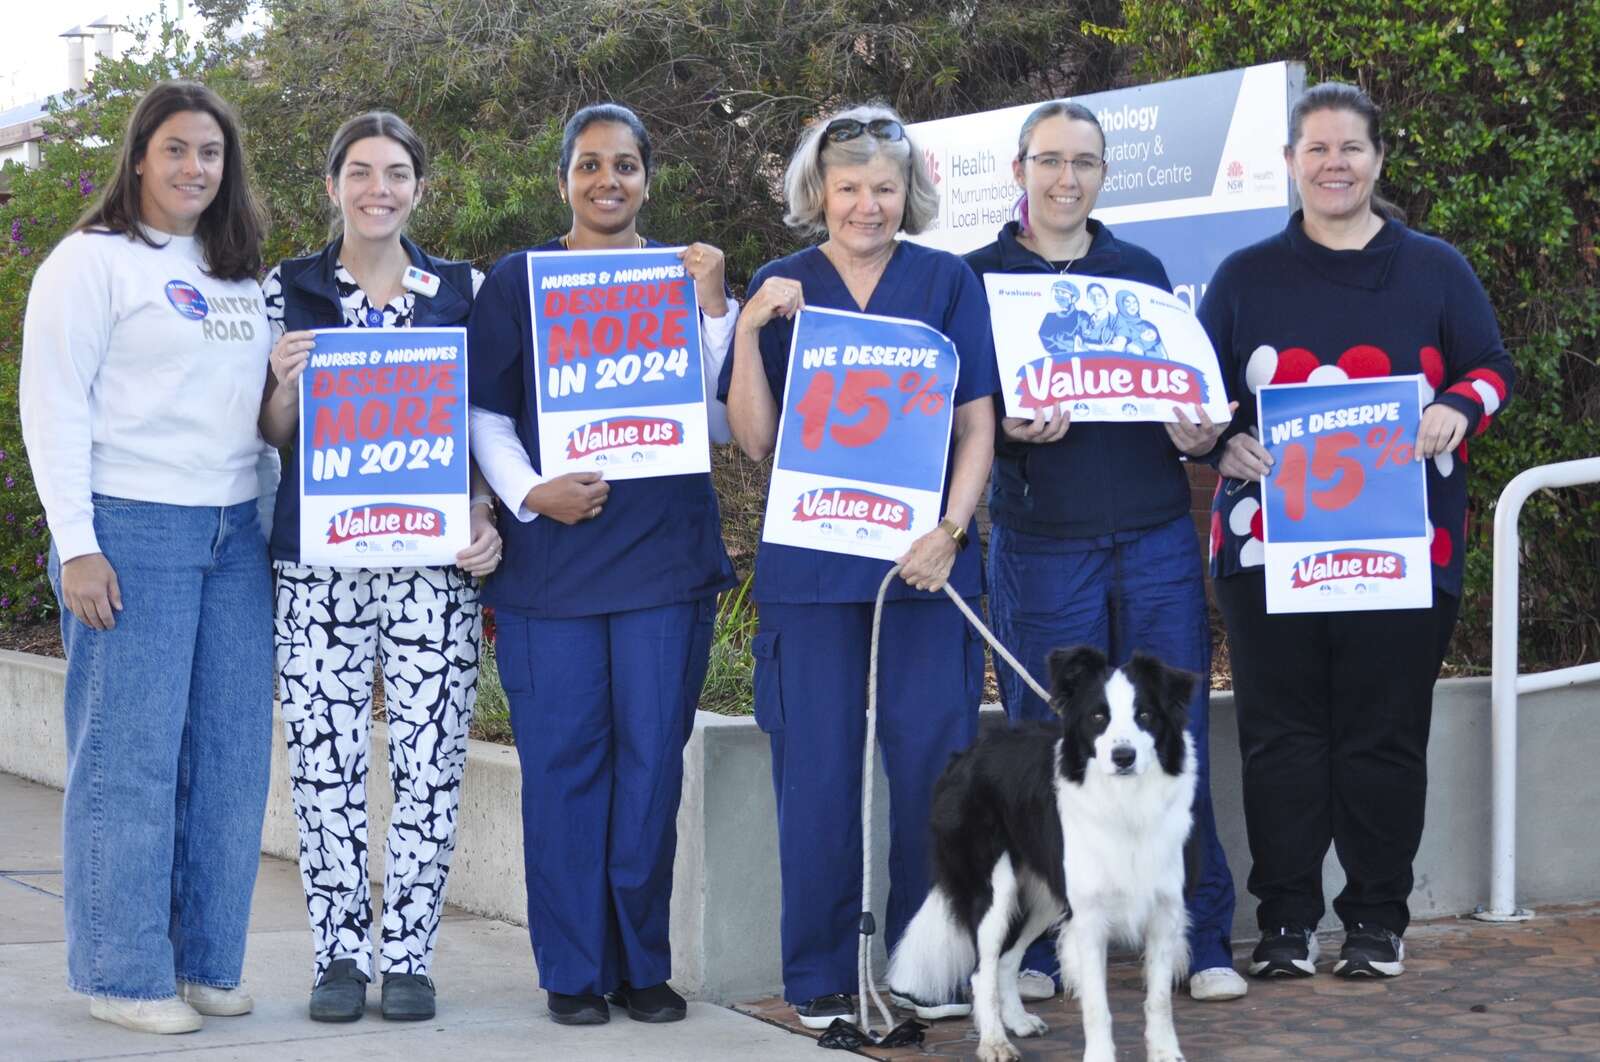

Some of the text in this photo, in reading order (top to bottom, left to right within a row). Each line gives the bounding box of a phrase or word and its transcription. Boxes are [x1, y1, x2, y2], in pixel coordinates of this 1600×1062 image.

[1097, 105, 1159, 132] thology
[951, 150, 996, 177] Health
[1104, 135, 1164, 162] oratory &
[1101, 163, 1192, 192] ection Centre
[951, 181, 1020, 206] Murrumbidge
[951, 207, 979, 228] Local
[541, 265, 685, 289] NURSES & MIDWIVES
[543, 281, 688, 318] DESERVE
[202, 319, 255, 341] ROAD
[548, 309, 688, 365] MORE
[311, 346, 458, 368] NURSES & MIDWIVES
[548, 347, 688, 398] IN 2024
[802, 345, 939, 369] WE DESERVE
[311, 363, 458, 399] DESERVE
[1024, 356, 1190, 401] Value us
[312, 395, 458, 449] MORE
[795, 370, 945, 452] 15%
[1271, 401, 1400, 445] WE DESERVE
[573, 421, 673, 453] Value us
[312, 436, 454, 481] IN 2024
[1274, 427, 1414, 522] 15%
[802, 488, 904, 523] Value us
[334, 507, 435, 538] Value us
[1300, 553, 1396, 582] Value us
